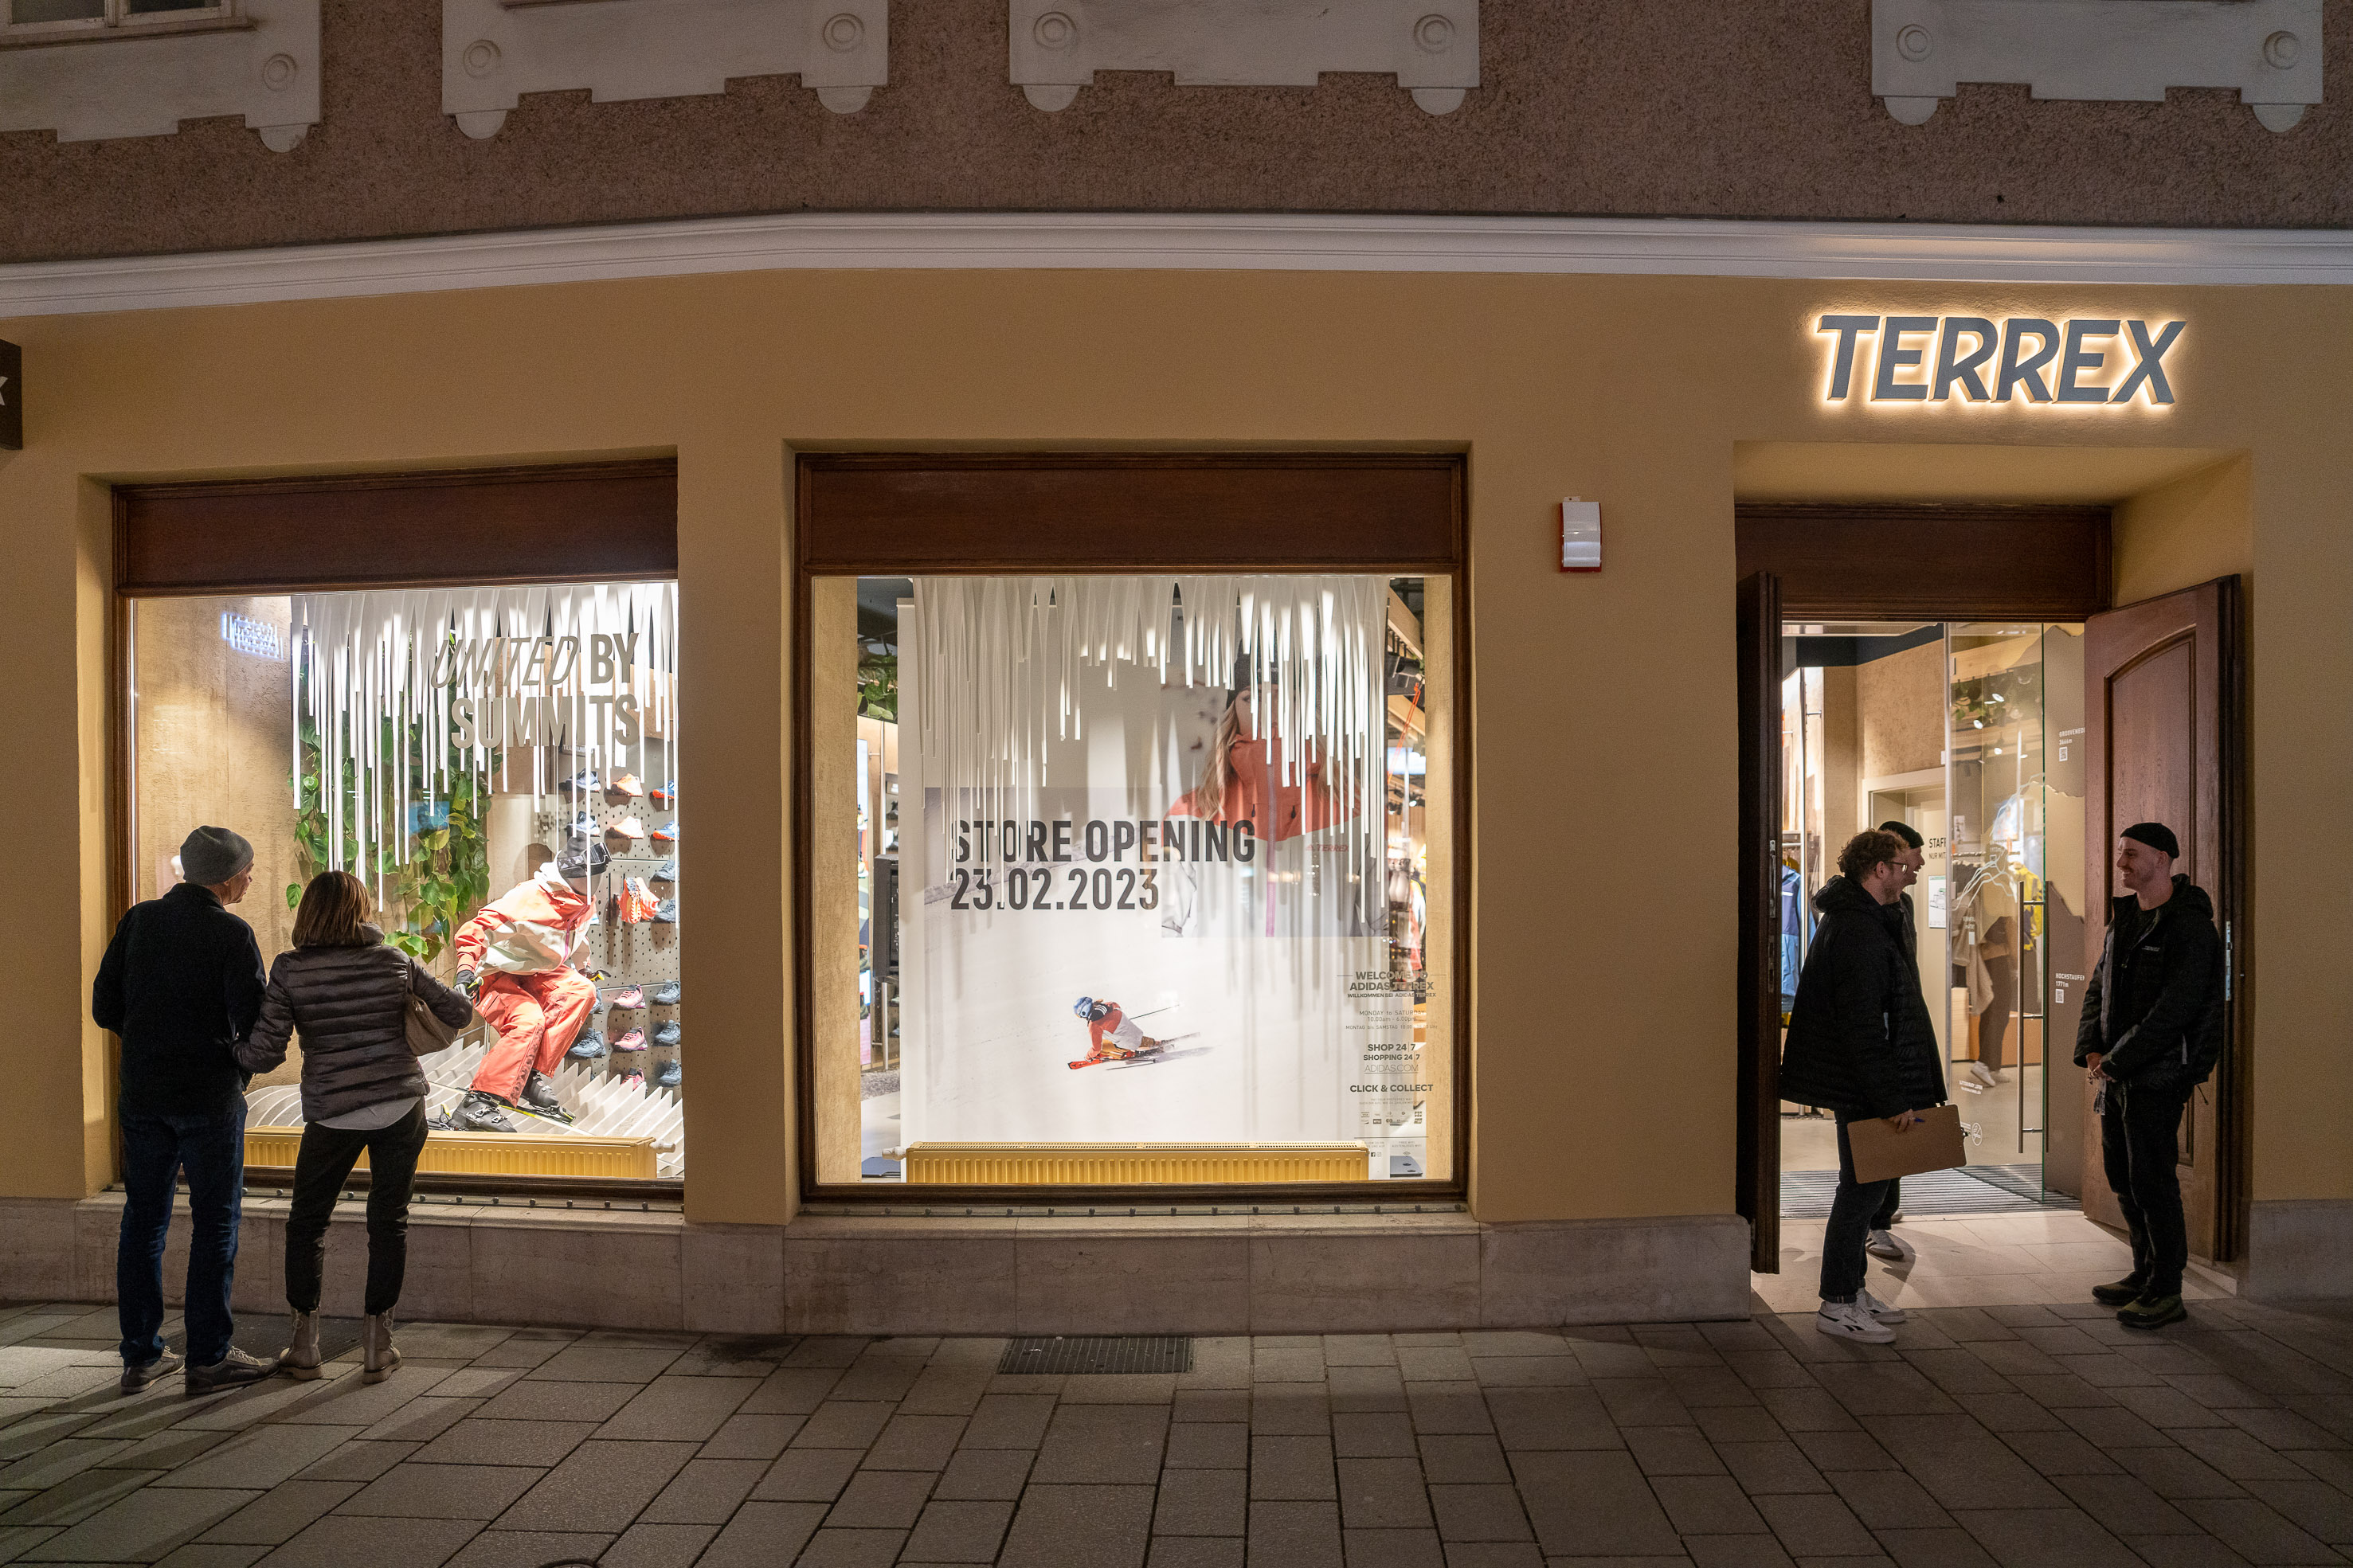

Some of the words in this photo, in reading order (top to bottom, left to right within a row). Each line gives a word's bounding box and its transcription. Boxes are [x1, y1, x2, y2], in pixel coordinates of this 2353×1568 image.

[1816, 315, 2187, 405] TERREX
[430, 635, 579, 689] UNITED
[590, 632, 640, 684] BY
[451, 693, 639, 749] SUMMITS
[951, 819, 1072, 862] STORE
[1085, 819, 1256, 862] OPENING
[949, 867, 1160, 911] 23.02.2023
[1349, 982, 1390, 991] ADIDAS
[1392, 981, 1435, 991] TERREX
[1355, 971, 1411, 980] WELCOME
[1413, 971, 1428, 980] TO
